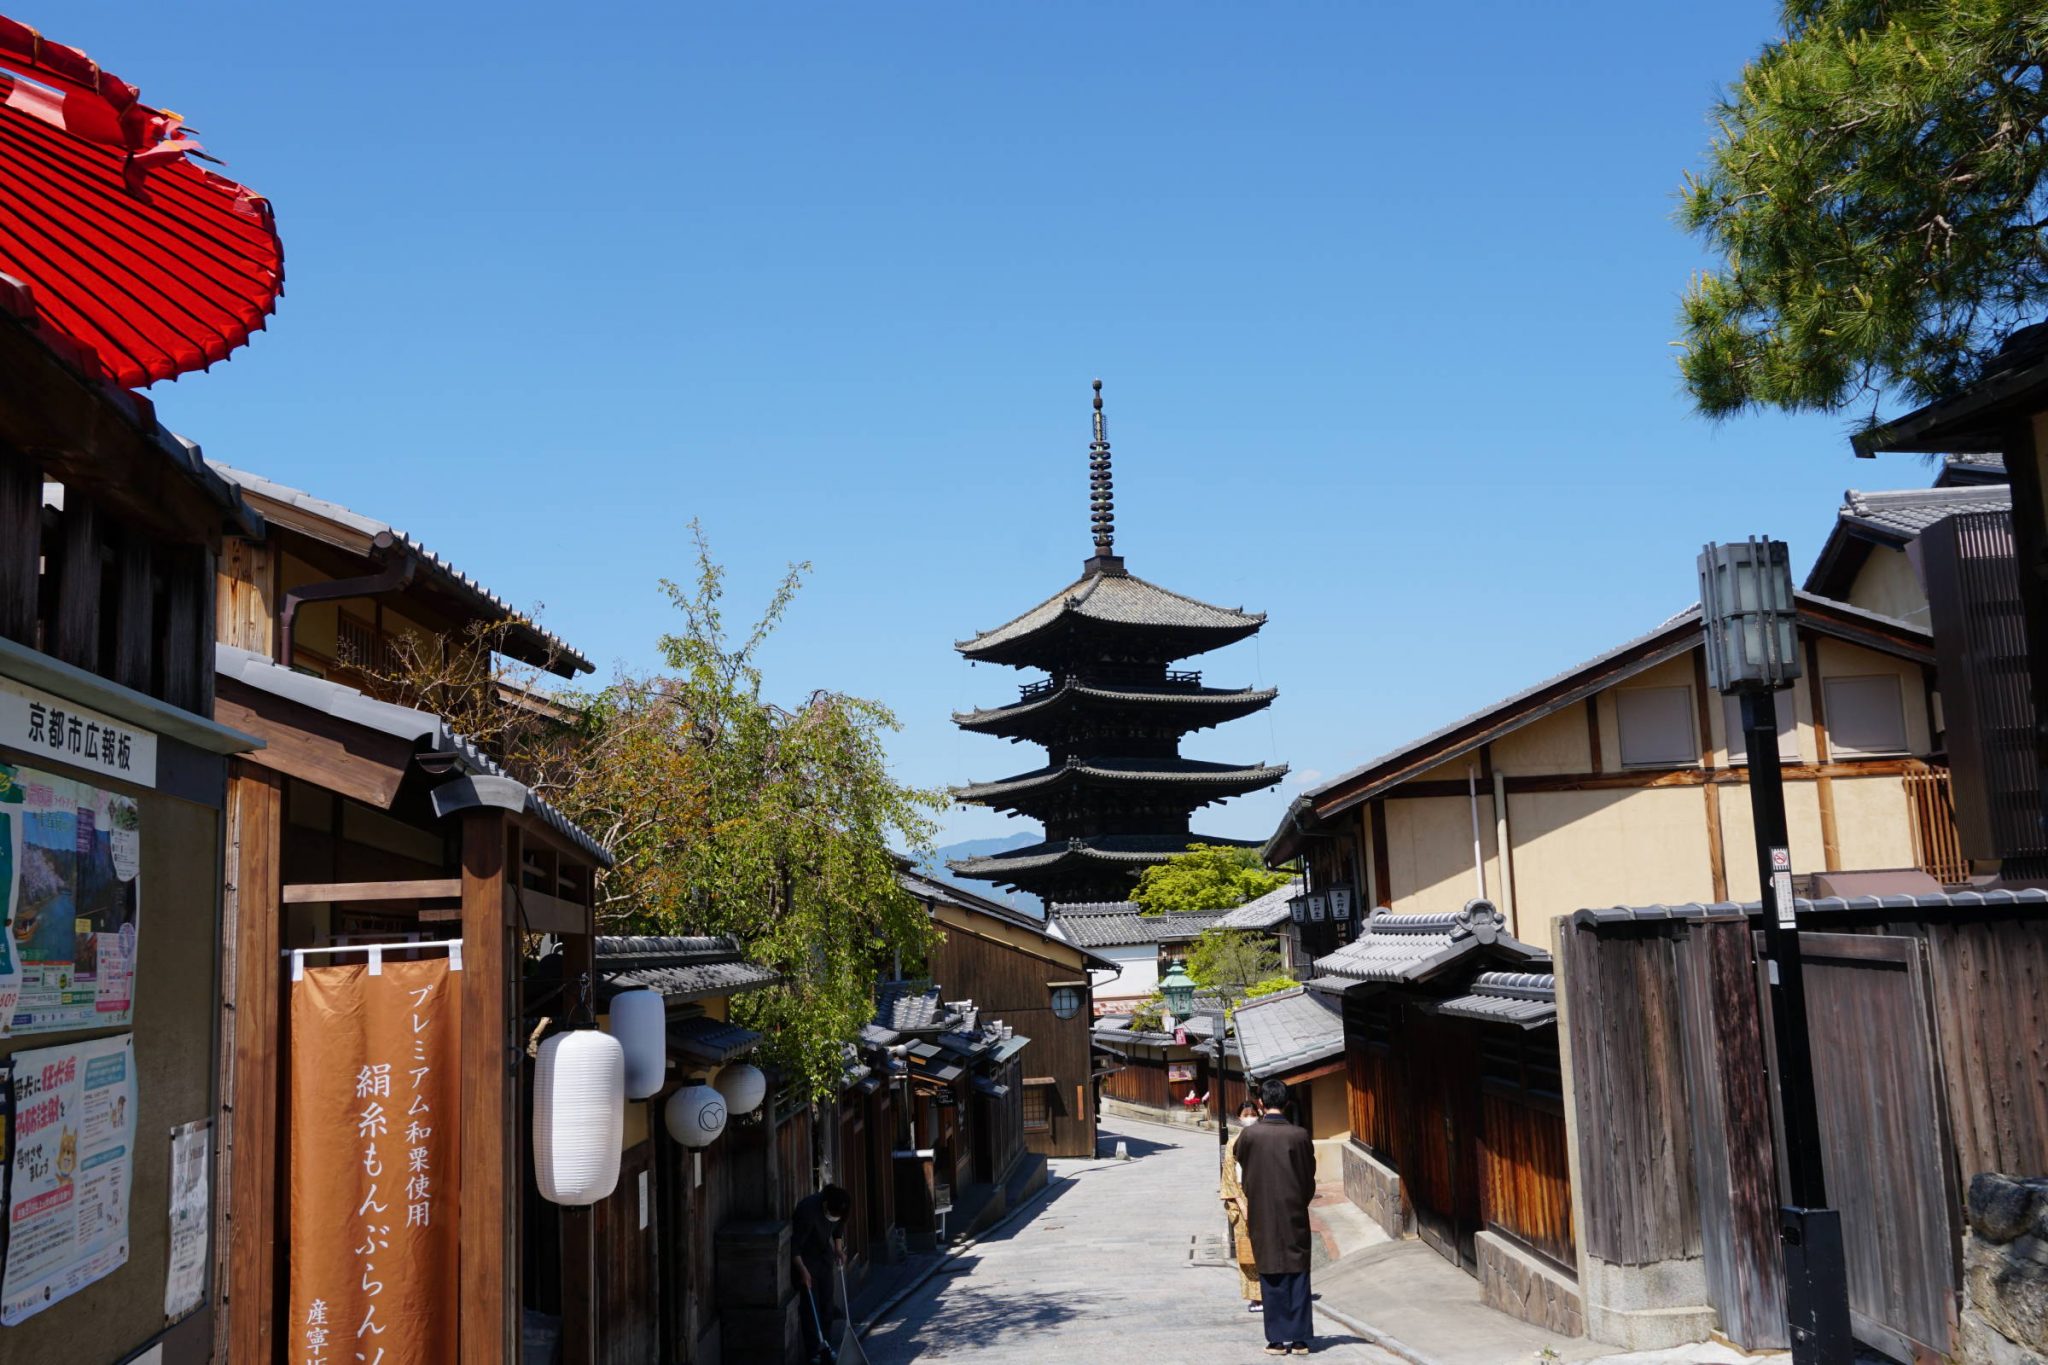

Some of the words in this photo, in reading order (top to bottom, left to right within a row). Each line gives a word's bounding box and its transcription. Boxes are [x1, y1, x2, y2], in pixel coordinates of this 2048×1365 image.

[28, 701, 132, 771] 京都市広報板
[405, 984, 434, 1228] プレミアム和栗使用
[306, 1298, 329, 1365] 産寧
